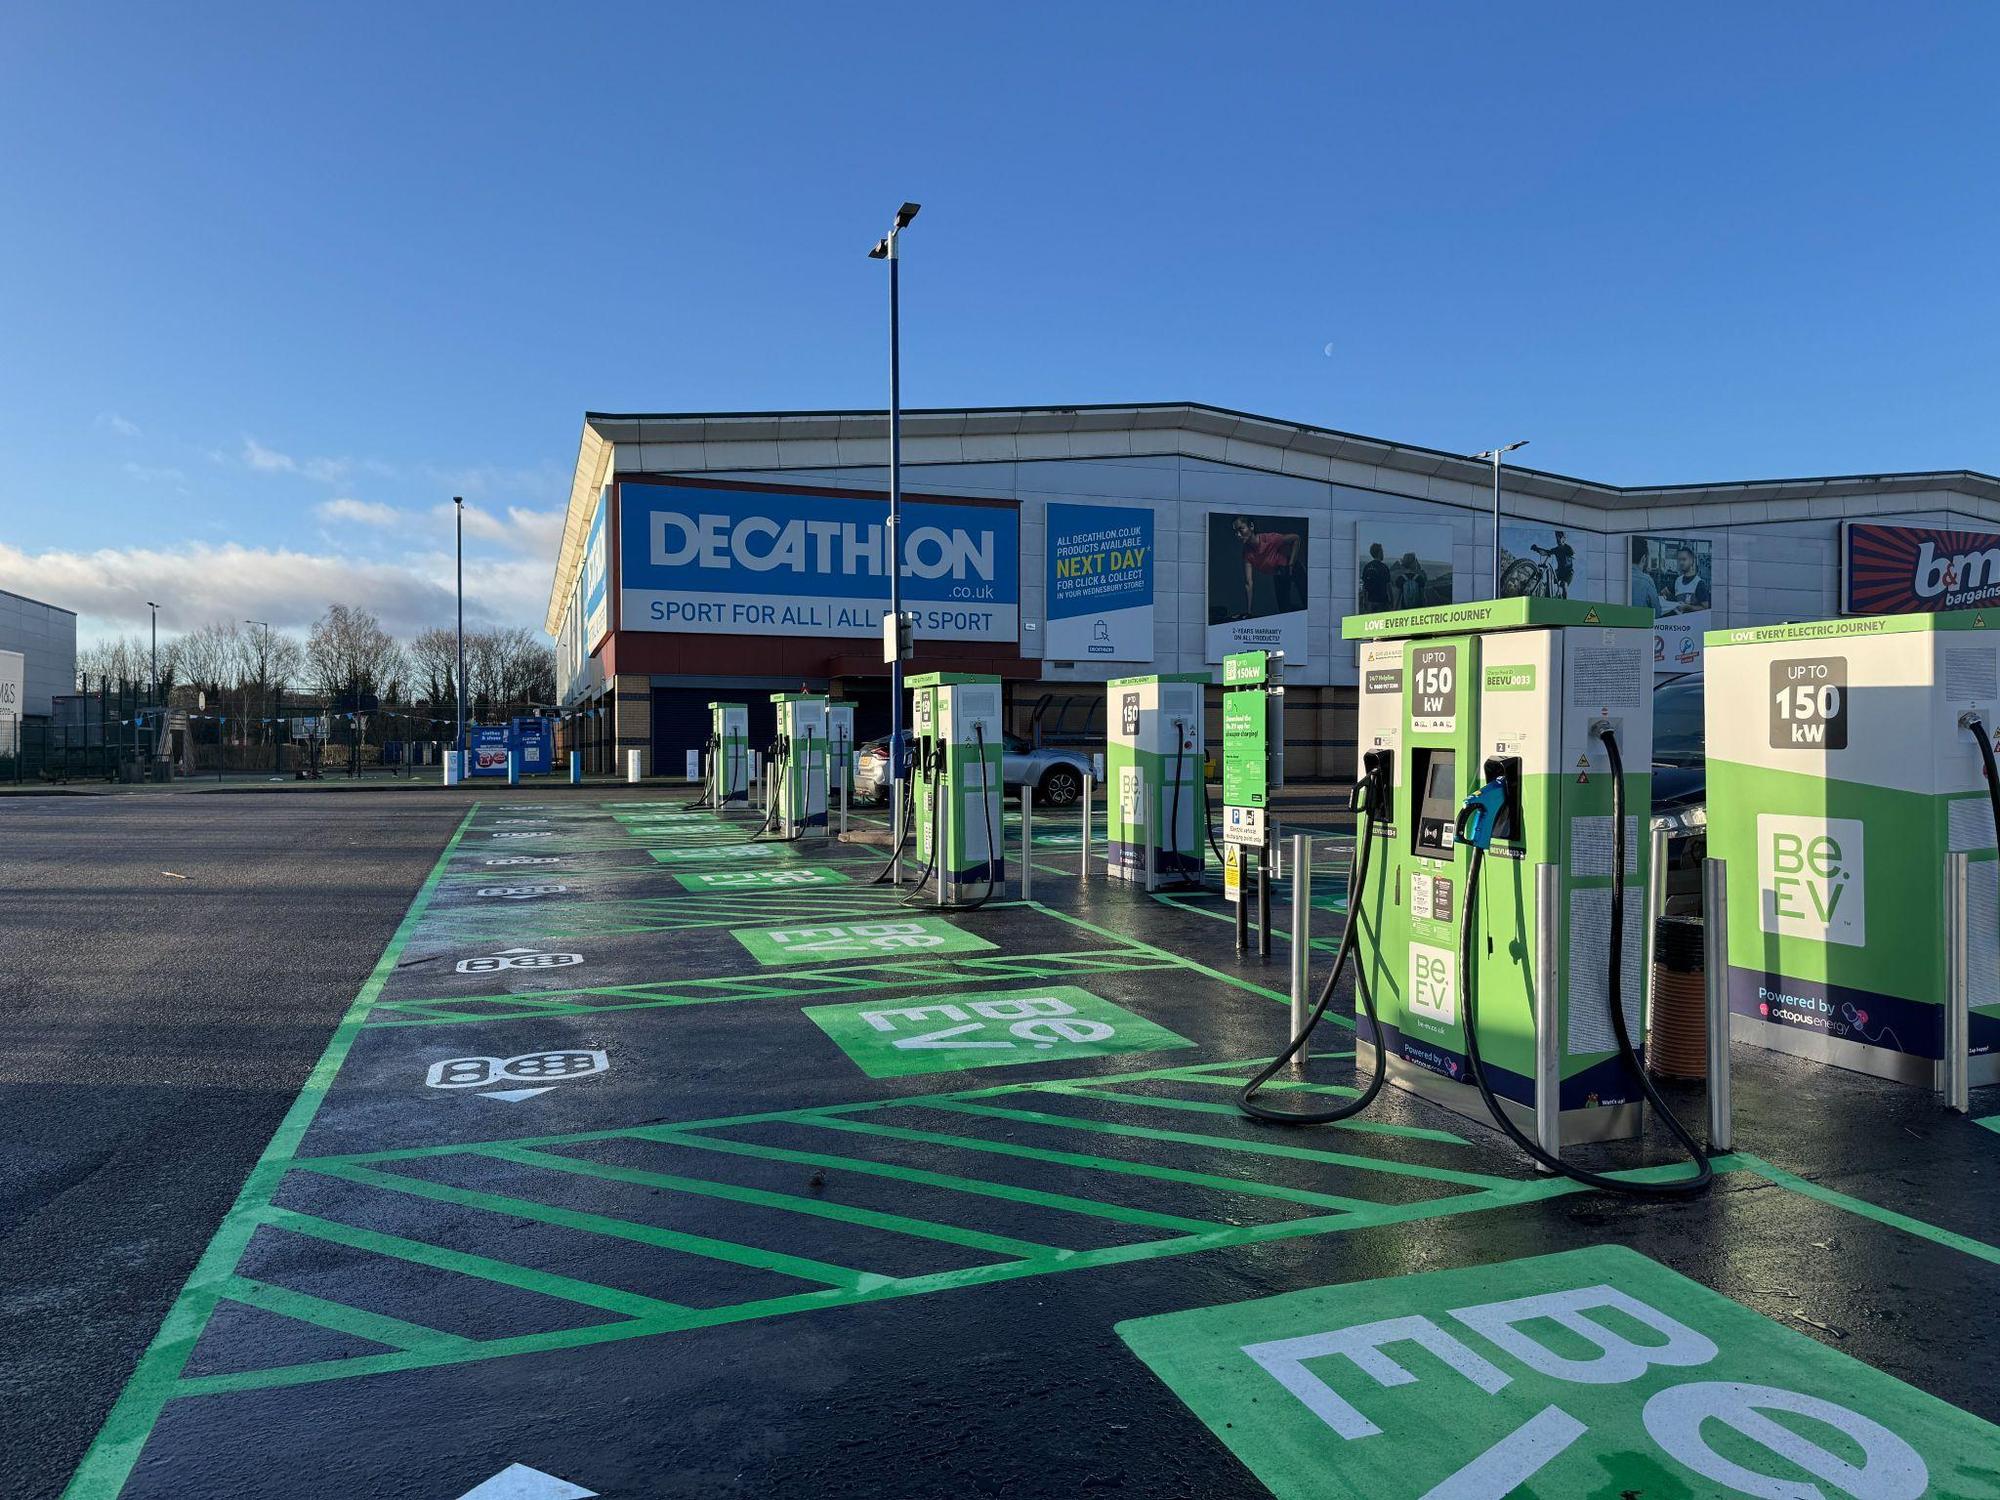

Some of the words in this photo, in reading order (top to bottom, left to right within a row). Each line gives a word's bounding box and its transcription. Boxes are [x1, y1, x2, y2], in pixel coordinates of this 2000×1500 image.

[650, 510, 994, 580] DECATHLON
[1057, 536, 1072, 546] ALL
[1073, 526, 1141, 543] DECATHLON.CO.UK
[1057, 543, 1099, 557] PRODUCTS
[1100, 537, 1142, 551] AVAILABLE
[1057, 553, 1105, 579] NEXT
[1057, 580, 1073, 590] FOR
[1075, 575, 1100, 588] CLICK
[1108, 569, 1143, 582] COLLECT
[949, 585, 994, 599] .co.uk
[1066, 589, 1082, 598] YOUR
[1945, 585, 2000, 606] bargains
[650, 601, 726, 623] SPORT
[732, 604, 775, 624] FOR
[781, 606, 822, 626] ALL
[837, 608, 877, 628] ALL
[928, 611, 993, 632] SPORT
[1364, 619, 1385, 631] LOVE
[1385, 616, 1409, 629] EVERY
[1410, 612, 1448, 626] ELECTRIC
[1449, 607, 1493, 622] JOURNEY
[1730, 632, 1756, 642] LOVE
[1756, 629, 1786, 641] EVERY
[1787, 624, 1834, 638] ELECTRIC
[1835, 620, 1887, 635] JOURNEY
[1422, 652, 1433, 664] UP
[1433, 652, 1446, 663] TO
[1415, 666, 1452, 696] 150
[1788, 665, 1805, 679] UP
[1807, 664, 1828, 678] TO
[1424, 696, 1443, 712] kW
[1776, 685, 1840, 720] 150
[1124, 704, 1139, 723] 150
[1791, 724, 1825, 743] kW
[1774, 876, 1845, 924] EV
[1758, 987, 1816, 1010] Powered
[1818, 997, 1835, 1016] by
[1404, 1043, 1434, 1061] Powered
[1433, 1054, 1443, 1066] by
